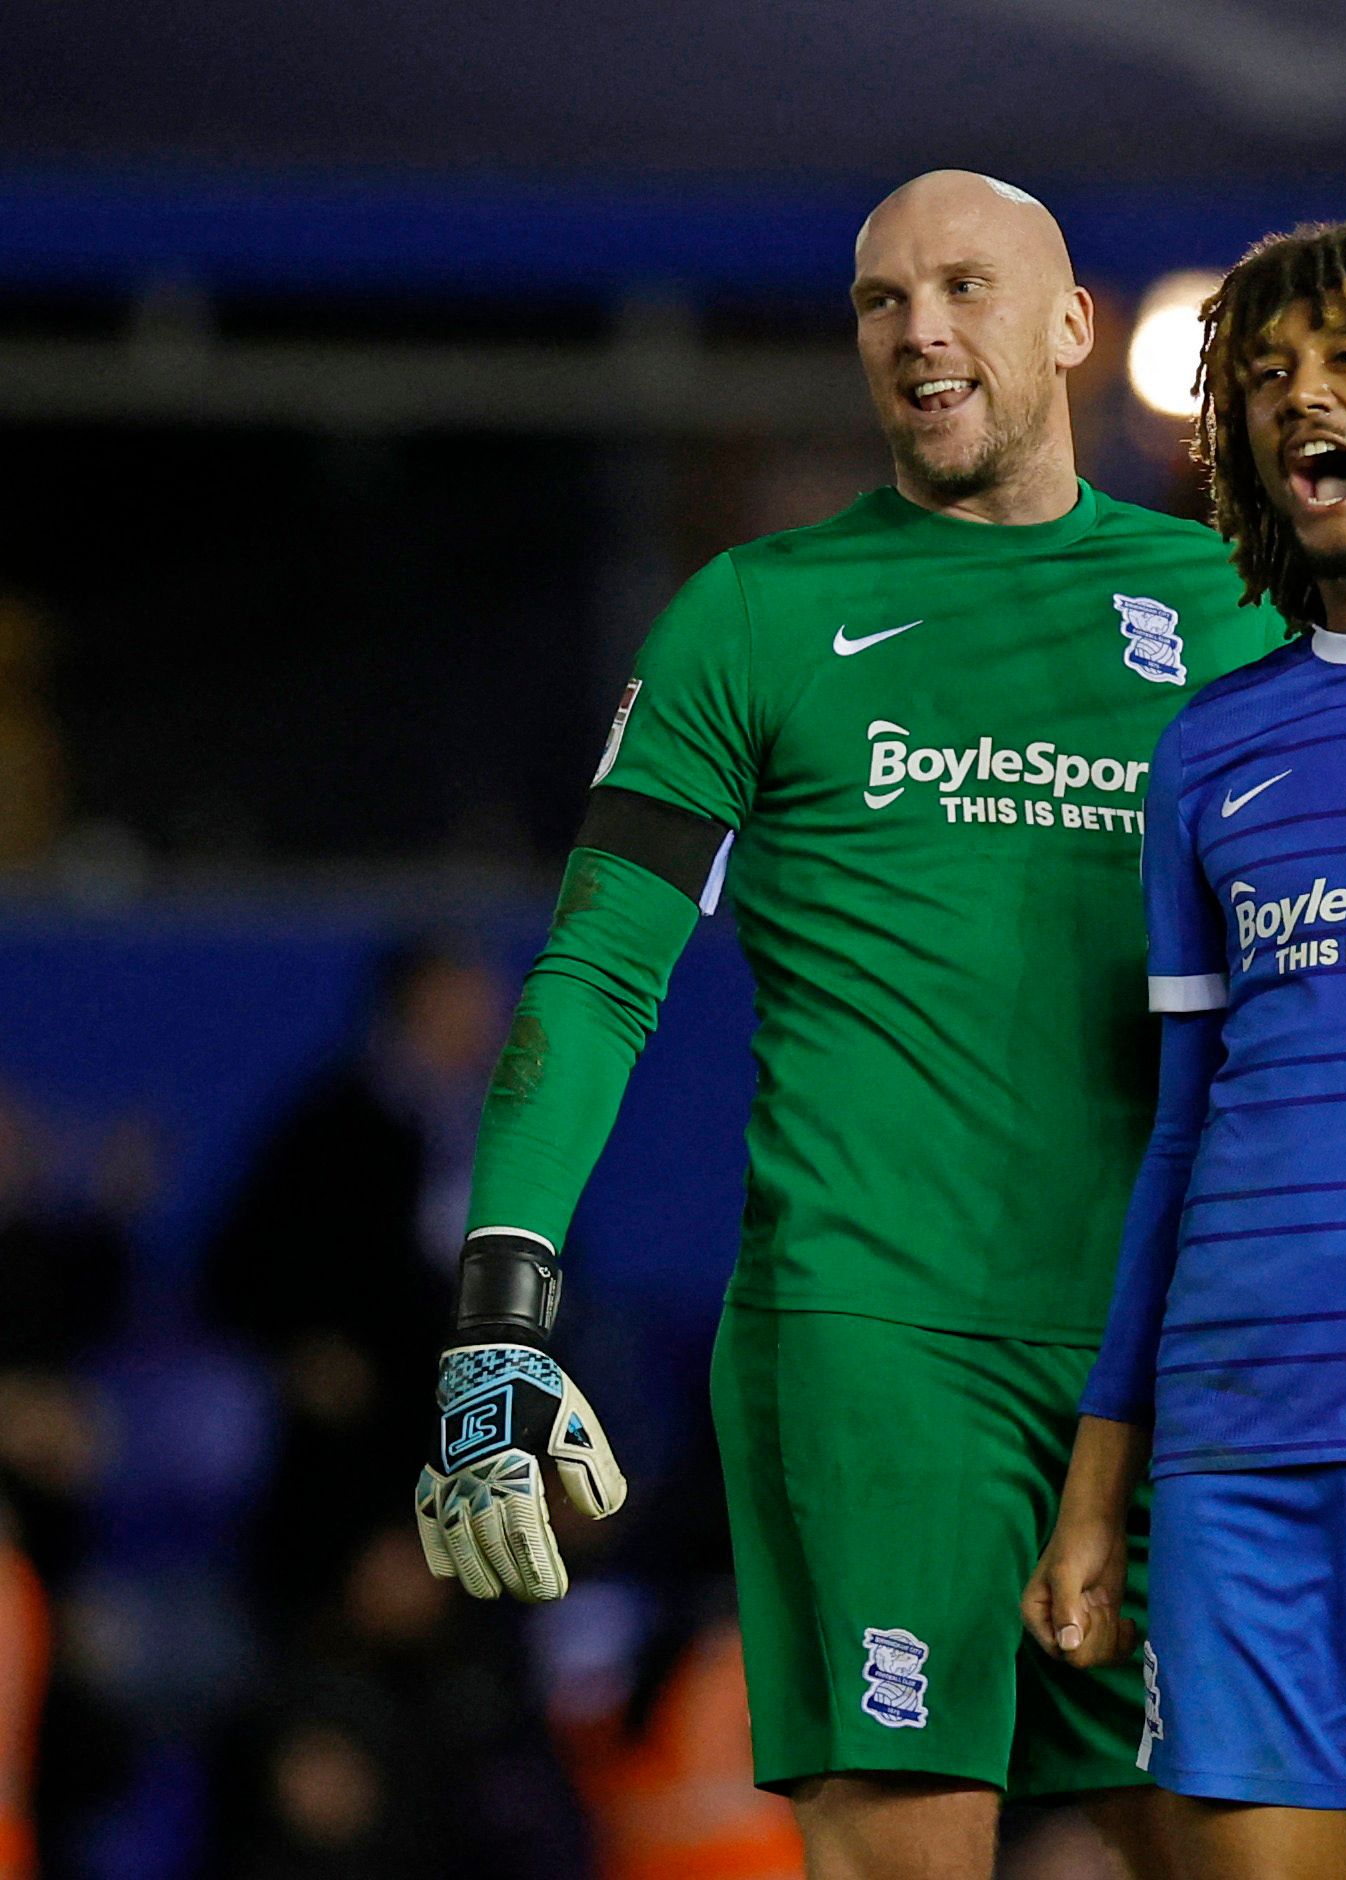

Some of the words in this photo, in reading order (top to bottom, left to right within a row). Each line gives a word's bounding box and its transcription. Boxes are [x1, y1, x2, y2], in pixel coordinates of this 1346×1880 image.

[868, 736, 1149, 798] BoyleSpor
[940, 797, 1017, 825] THIS
[1025, 799, 1055, 828] IS
[1061, 803, 1145, 835] BETTI
[1275, 938, 1339, 975] THIS
